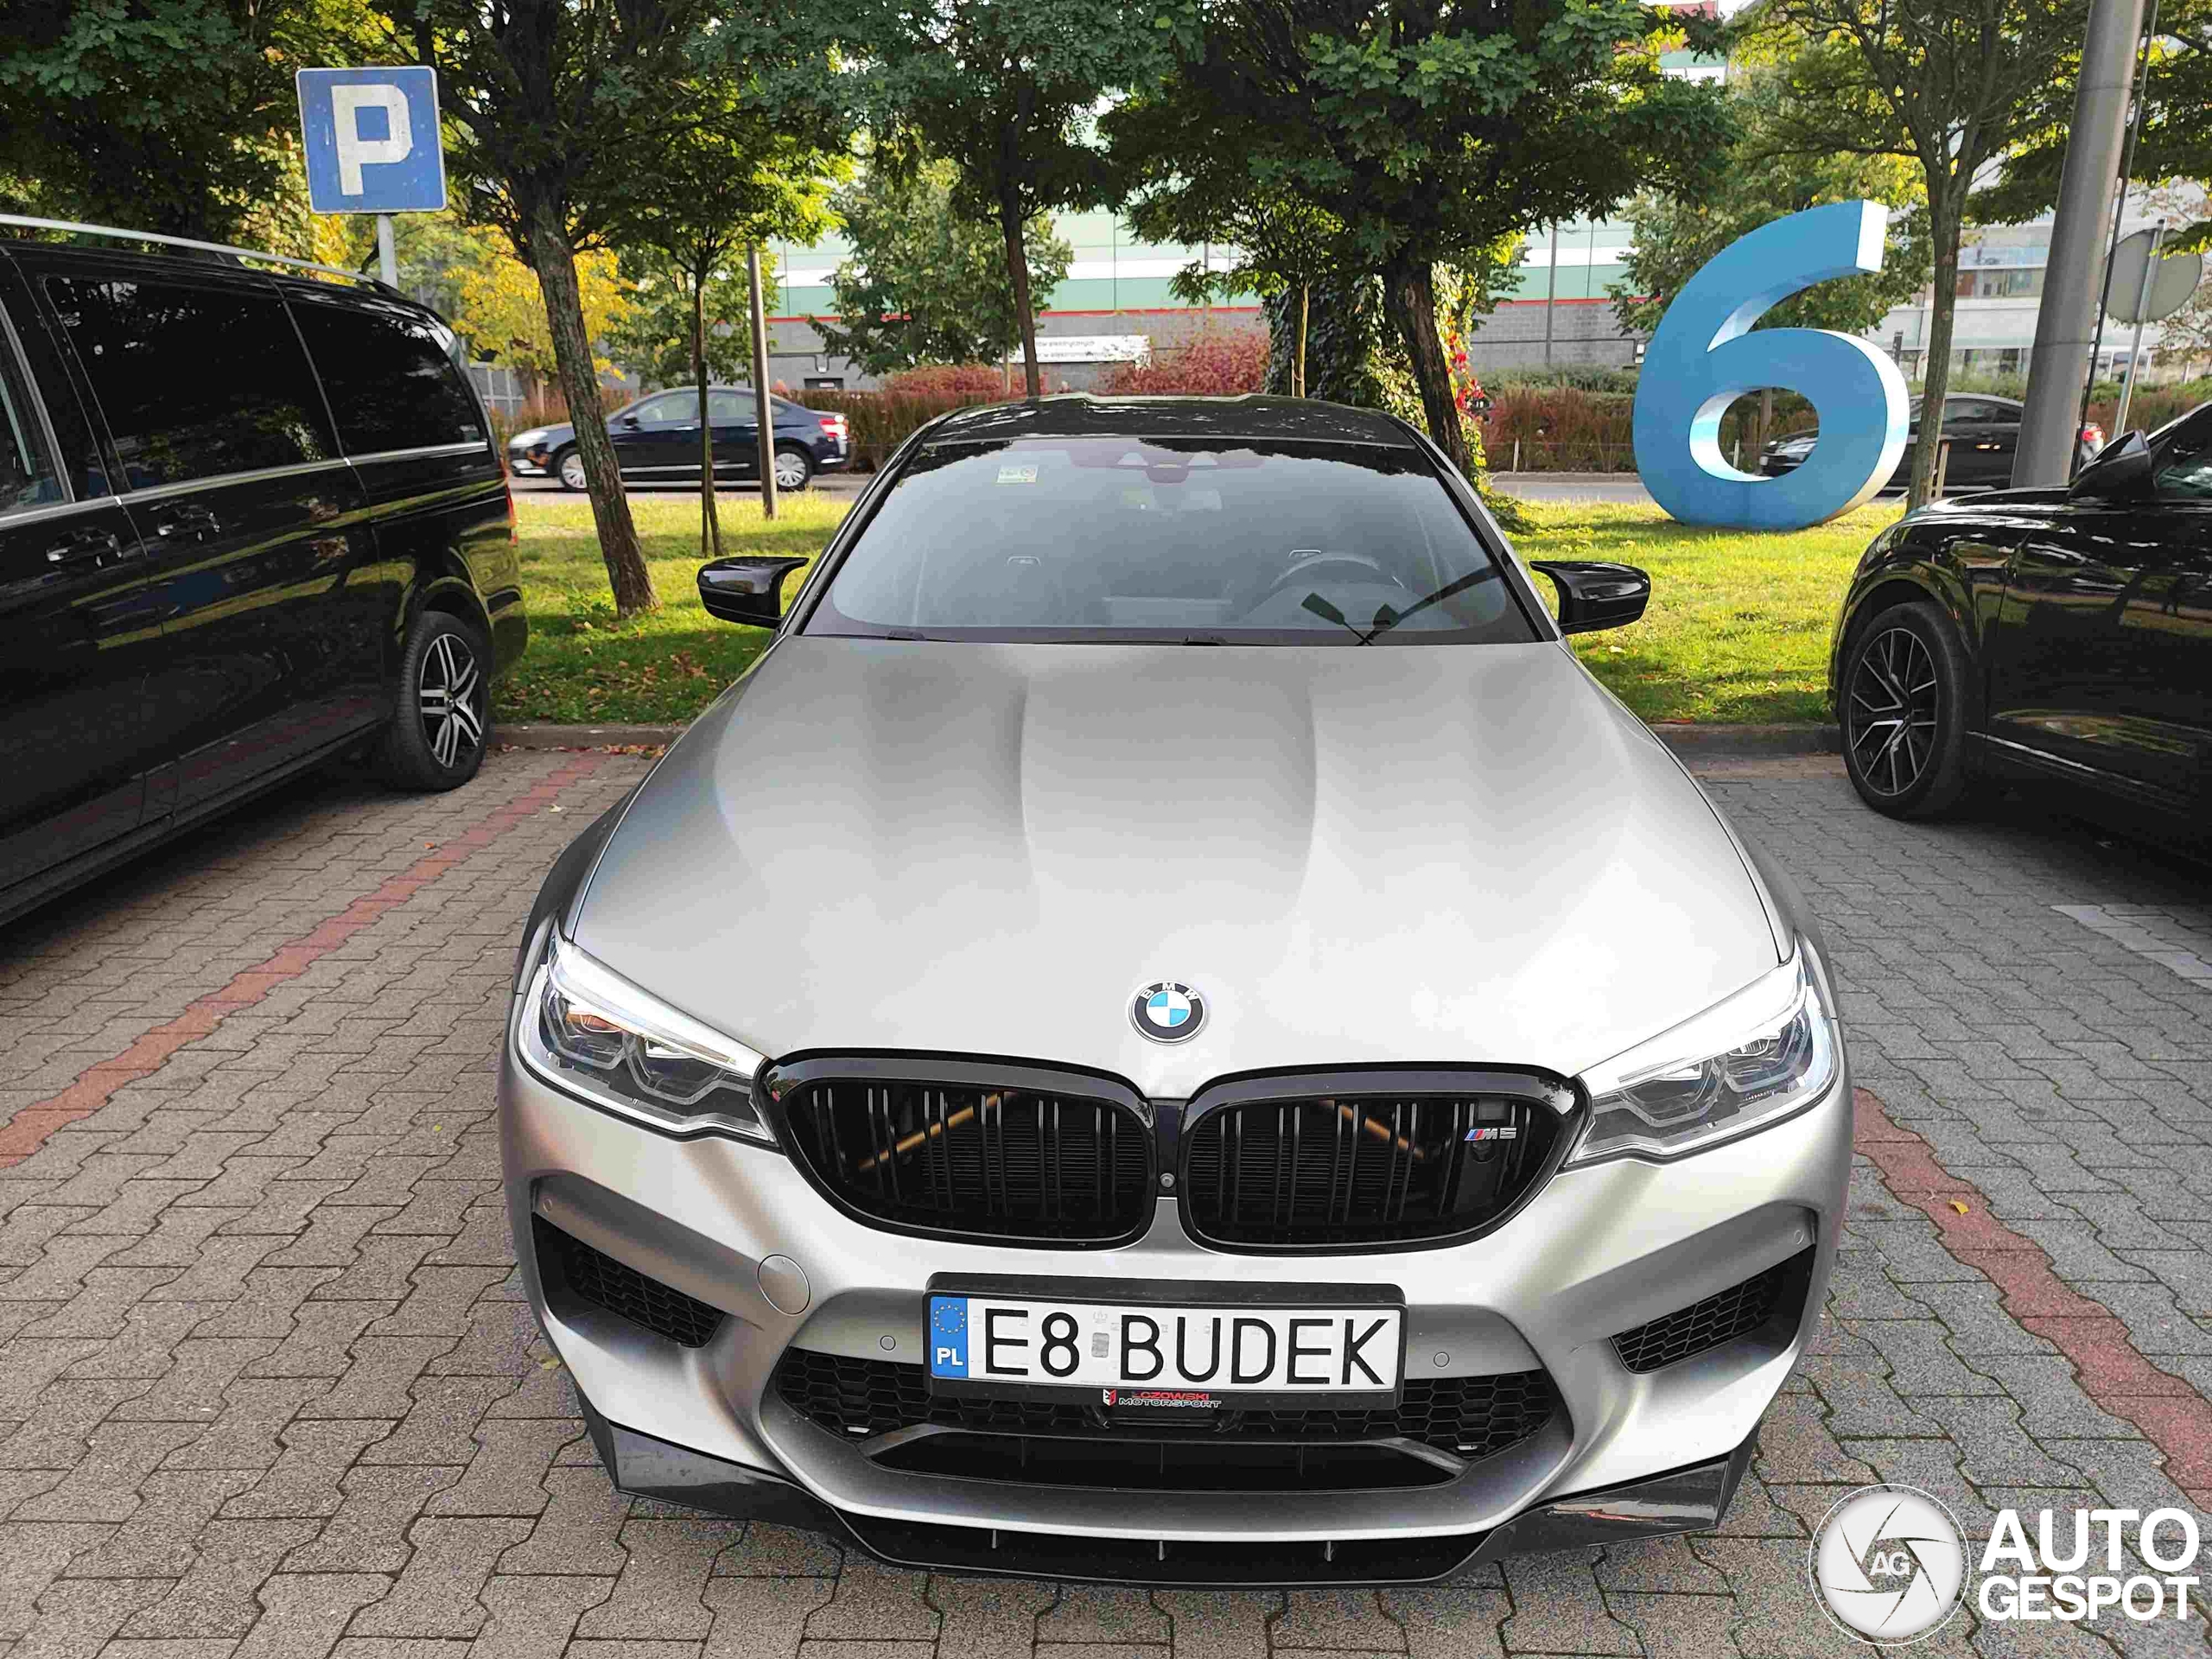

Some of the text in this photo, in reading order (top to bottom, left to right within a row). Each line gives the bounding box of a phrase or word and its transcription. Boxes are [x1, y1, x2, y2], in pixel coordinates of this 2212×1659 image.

[331, 84, 413, 196] P
[1632, 199, 1910, 531] 6
[1140, 982, 1200, 1001] BMW
[937, 1347, 964, 1367] PL
[985, 1307, 1389, 1386] E8 BUDEK
[1119, 1397, 1222, 1408] MOTORSPORT
